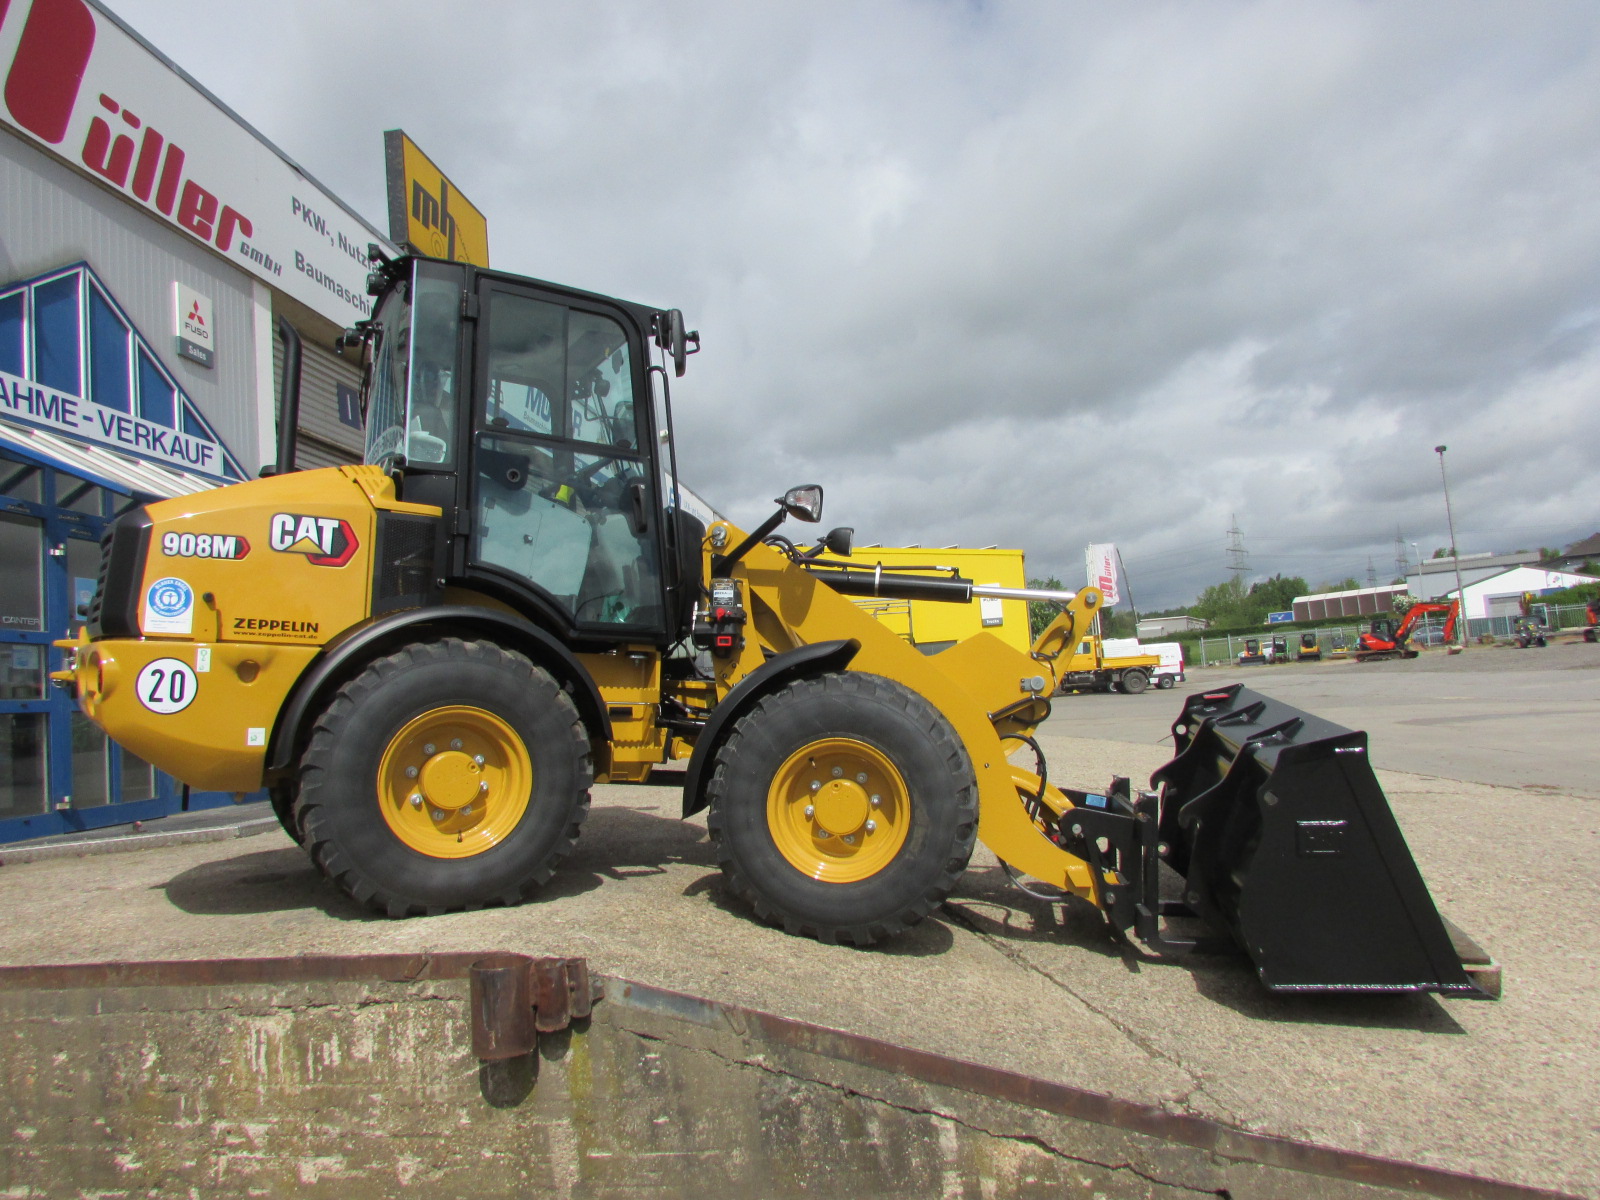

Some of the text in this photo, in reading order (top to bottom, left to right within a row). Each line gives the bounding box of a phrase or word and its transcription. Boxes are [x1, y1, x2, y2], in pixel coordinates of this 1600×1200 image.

[294, 249, 375, 317] Baumaschi
[184, 322, 209, 339] FUSO
[188, 345, 207, 361] Sales
[271, 513, 339, 555] CAT
[163, 532, 237, 559] 908M
[2, 615, 40, 626] CANTER
[233, 617, 319, 633] ZEPPELIN
[148, 668, 186, 704] 20
